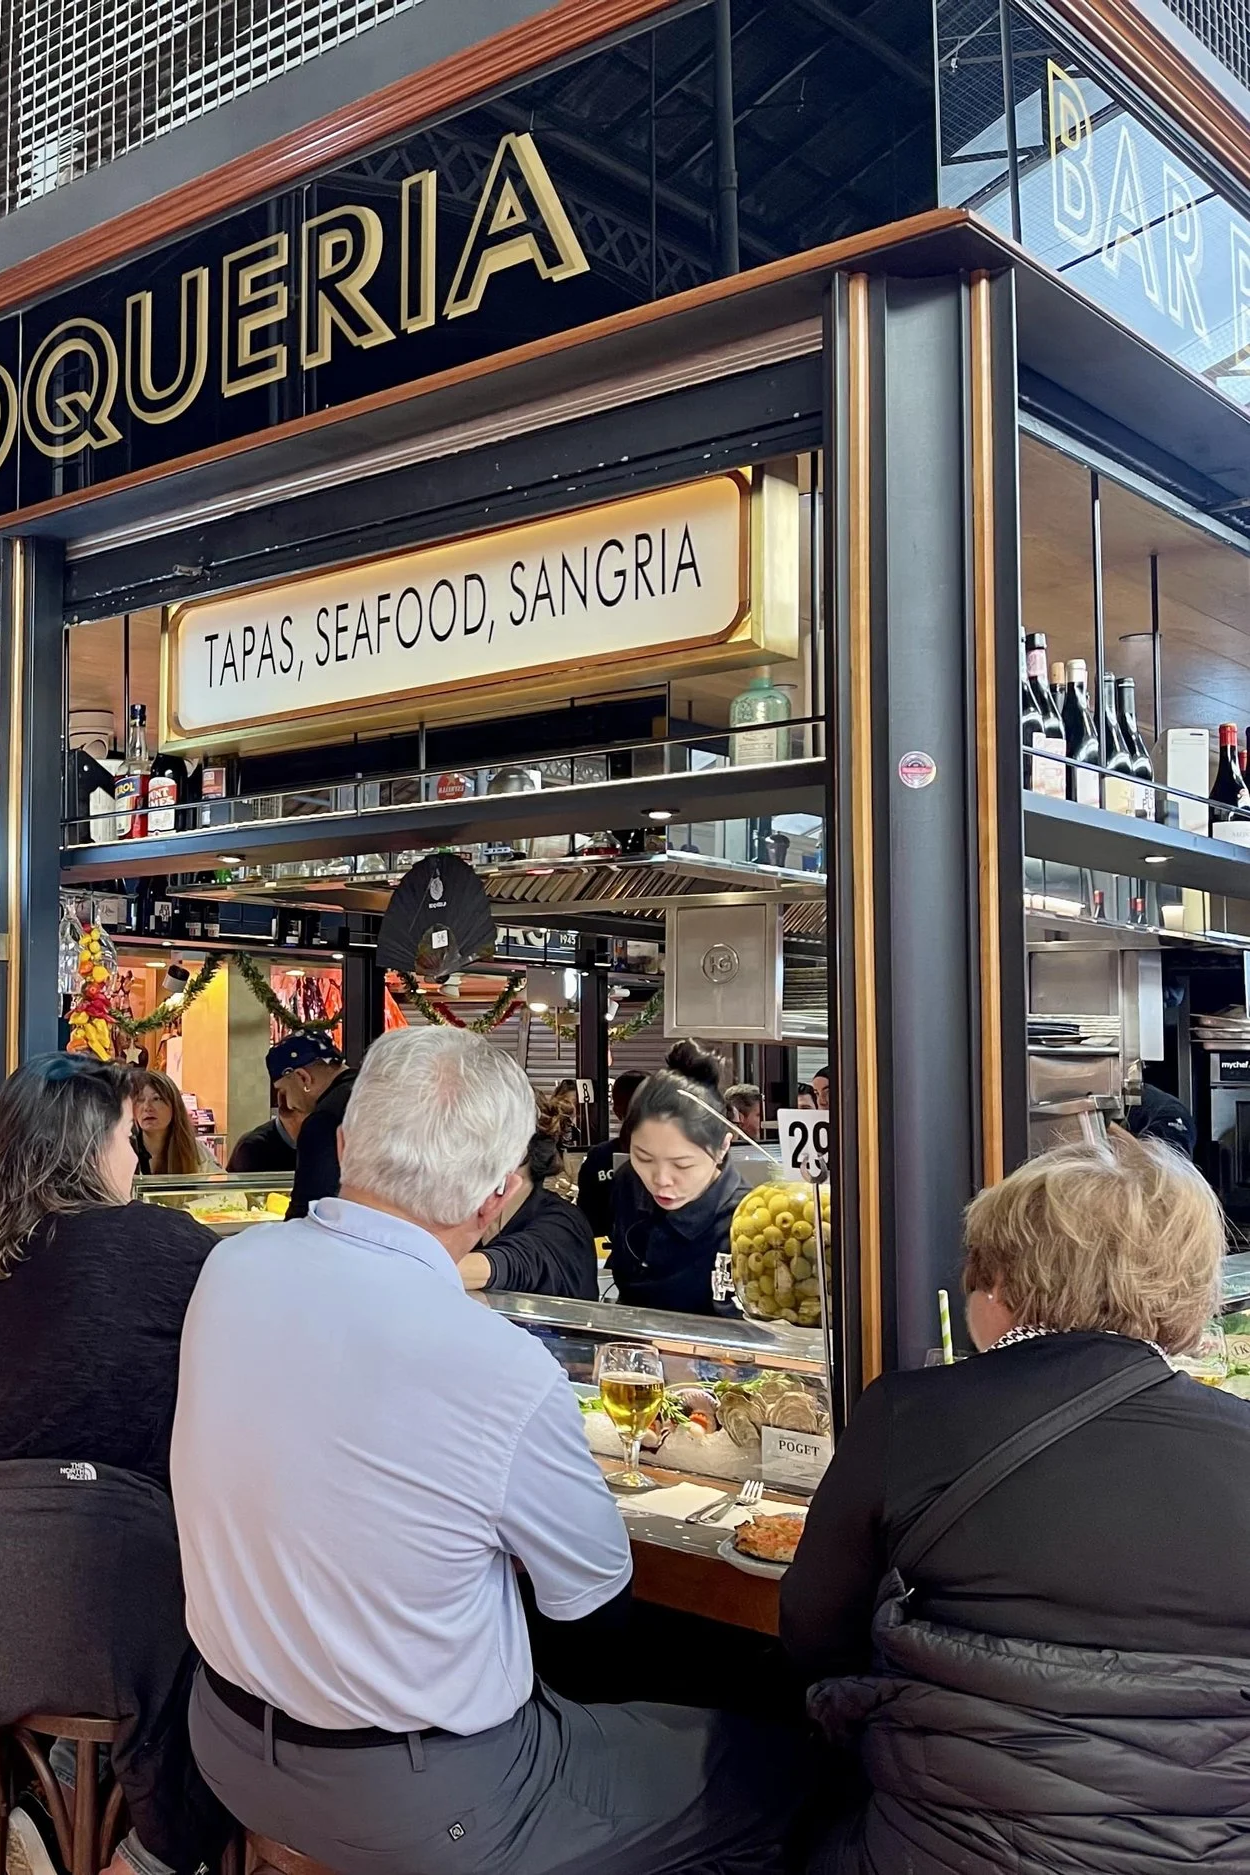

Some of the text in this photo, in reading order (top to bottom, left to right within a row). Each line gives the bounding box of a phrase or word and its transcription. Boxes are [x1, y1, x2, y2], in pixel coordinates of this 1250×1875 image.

[1047, 58, 1210, 346] BAR
[205, 521, 702, 688] TAPAS, SEAFOOD, SANGRIA
[788, 1120, 830, 1171] 29
[779, 1440, 820, 1456] POGET
